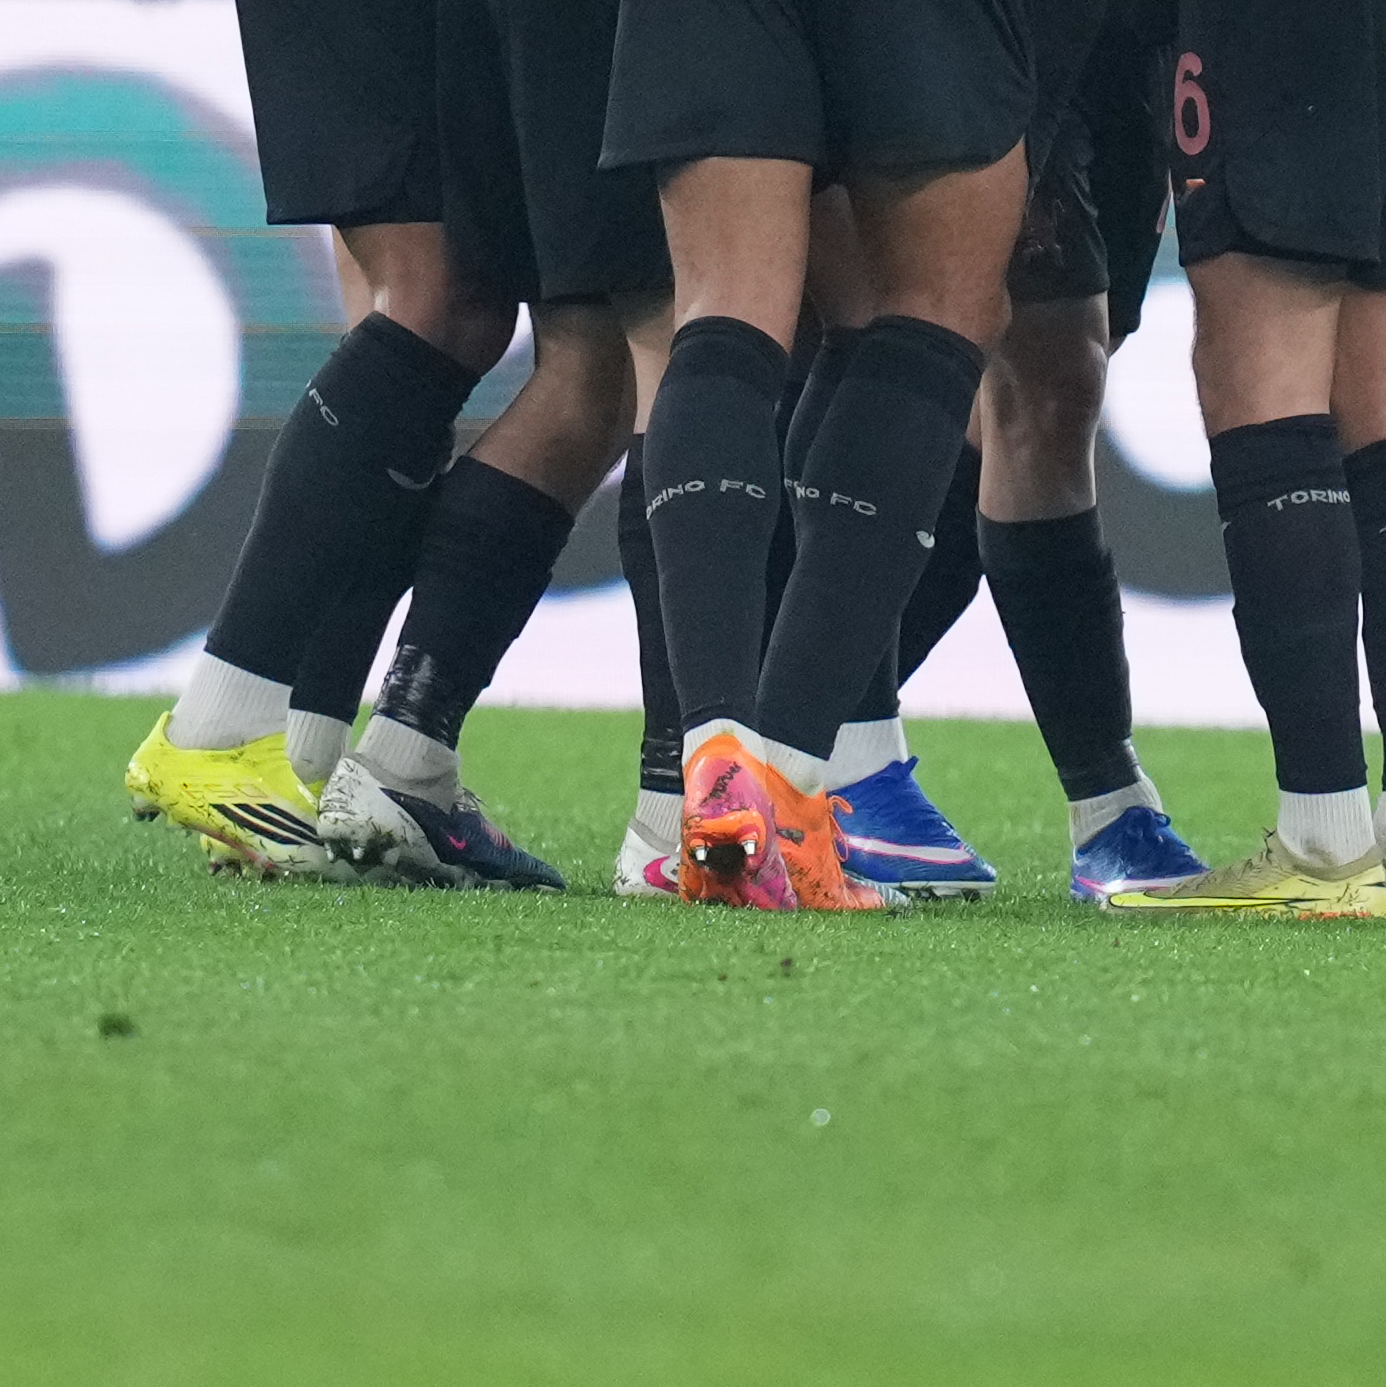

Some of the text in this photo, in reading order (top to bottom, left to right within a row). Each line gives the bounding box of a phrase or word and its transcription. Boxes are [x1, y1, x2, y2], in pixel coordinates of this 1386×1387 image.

[646, 480, 706, 520] ORINO
[720, 479, 766, 499] FC
[830, 492, 877, 516] FC
[1267, 488, 1351, 512] TORINO
